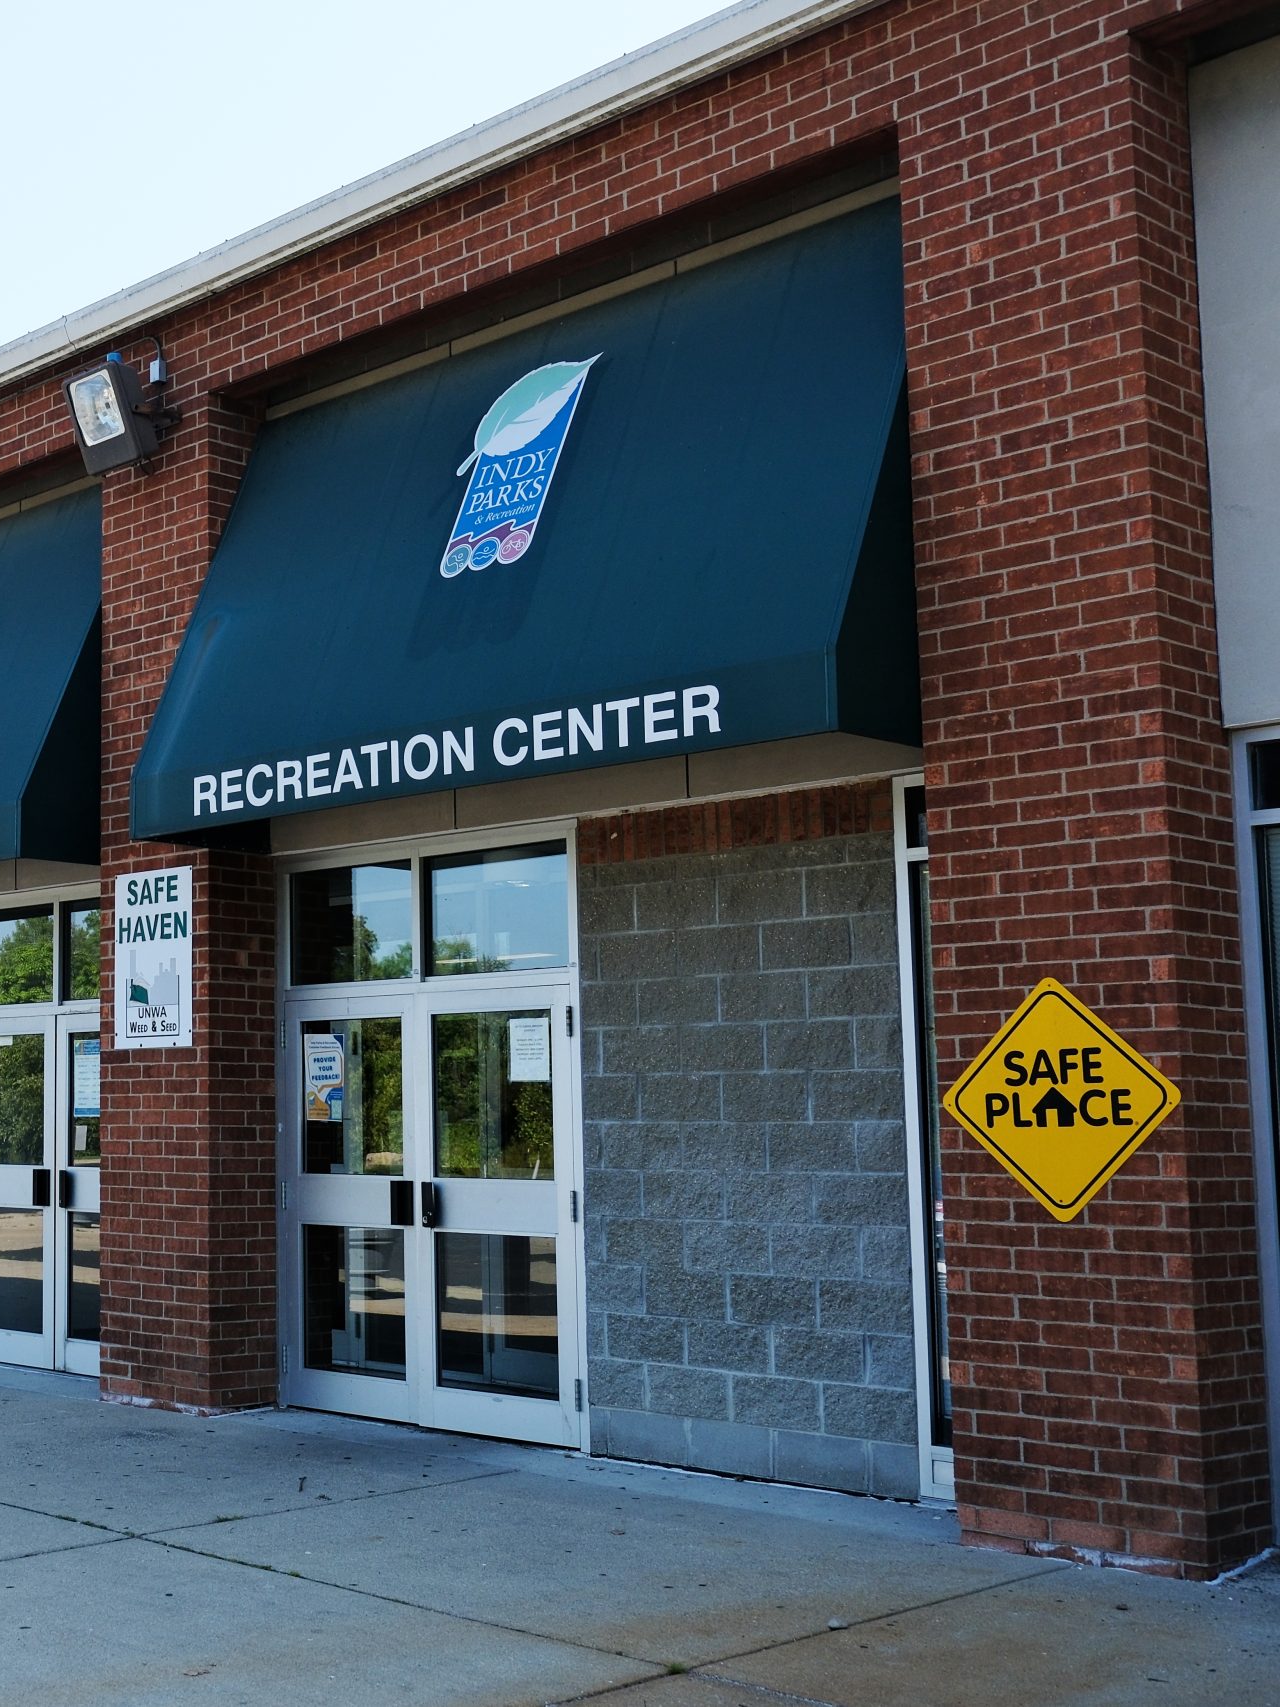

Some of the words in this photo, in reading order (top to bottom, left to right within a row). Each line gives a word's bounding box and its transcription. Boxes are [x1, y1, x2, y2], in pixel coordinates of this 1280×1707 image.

[474, 446, 556, 489] INDY
[466, 475, 545, 515] PARKS
[474, 516, 484, 525] &
[485, 503, 536, 523] Recreation
[193, 726, 475, 816] RECREATION
[492, 684, 721, 767] CENTER
[127, 874, 179, 906] SAFE
[118, 910, 188, 944] HAVEN
[137, 1006, 167, 1019] UNWA
[151, 1020, 157, 1032] &
[1004, 1047, 1104, 1086] SAFE
